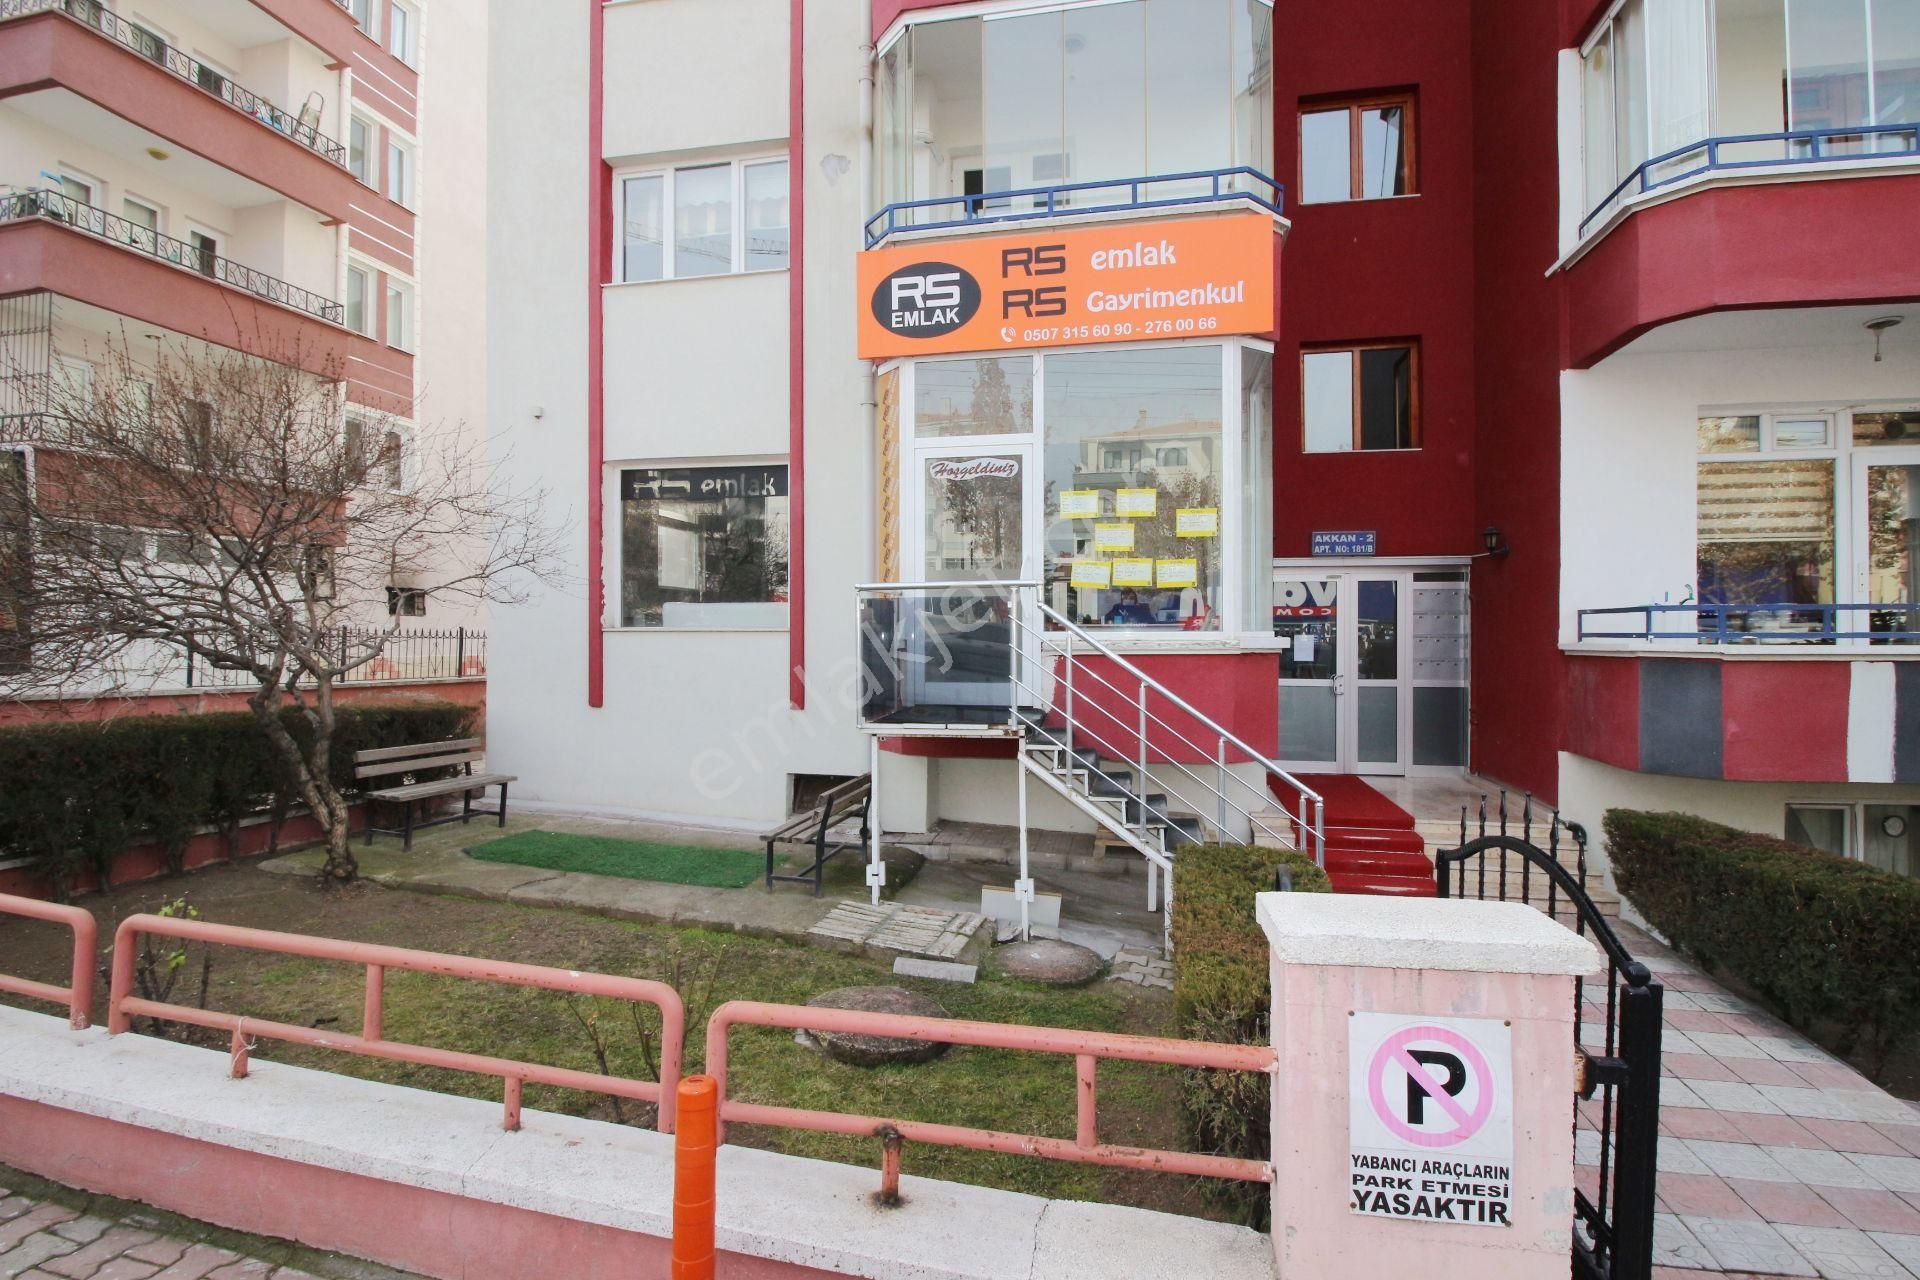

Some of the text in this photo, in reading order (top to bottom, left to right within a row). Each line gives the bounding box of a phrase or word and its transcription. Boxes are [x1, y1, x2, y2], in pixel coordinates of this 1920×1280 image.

[1002, 240, 1176, 279] RS emlak
[891, 272, 960, 310] RS
[1002, 281, 1244, 320] RS Gayrimenkul
[891, 307, 960, 329] EMLAK
[1023, 327, 1059, 342] 0507
[1062, 325, 1089, 340] 315
[1092, 324, 1110, 338] 60
[1114, 322, 1132, 336] 90
[1145, 320, 1171, 334] 276
[1175, 318, 1194, 333] 00
[1198, 317, 1216, 331] 66
[701, 473, 776, 496] emlak
[1314, 534, 1356, 543] AKKAN
[1366, 534, 1374, 542] 2
[1314, 544, 1373, 553] APT. NO: 181/B
[1351, 1154, 1510, 1181] YABANCI ARAÇLARIN
[1352, 1174, 1509, 1199] PARK ETMESİ
[1352, 1188, 1509, 1223] YASAKTIR
